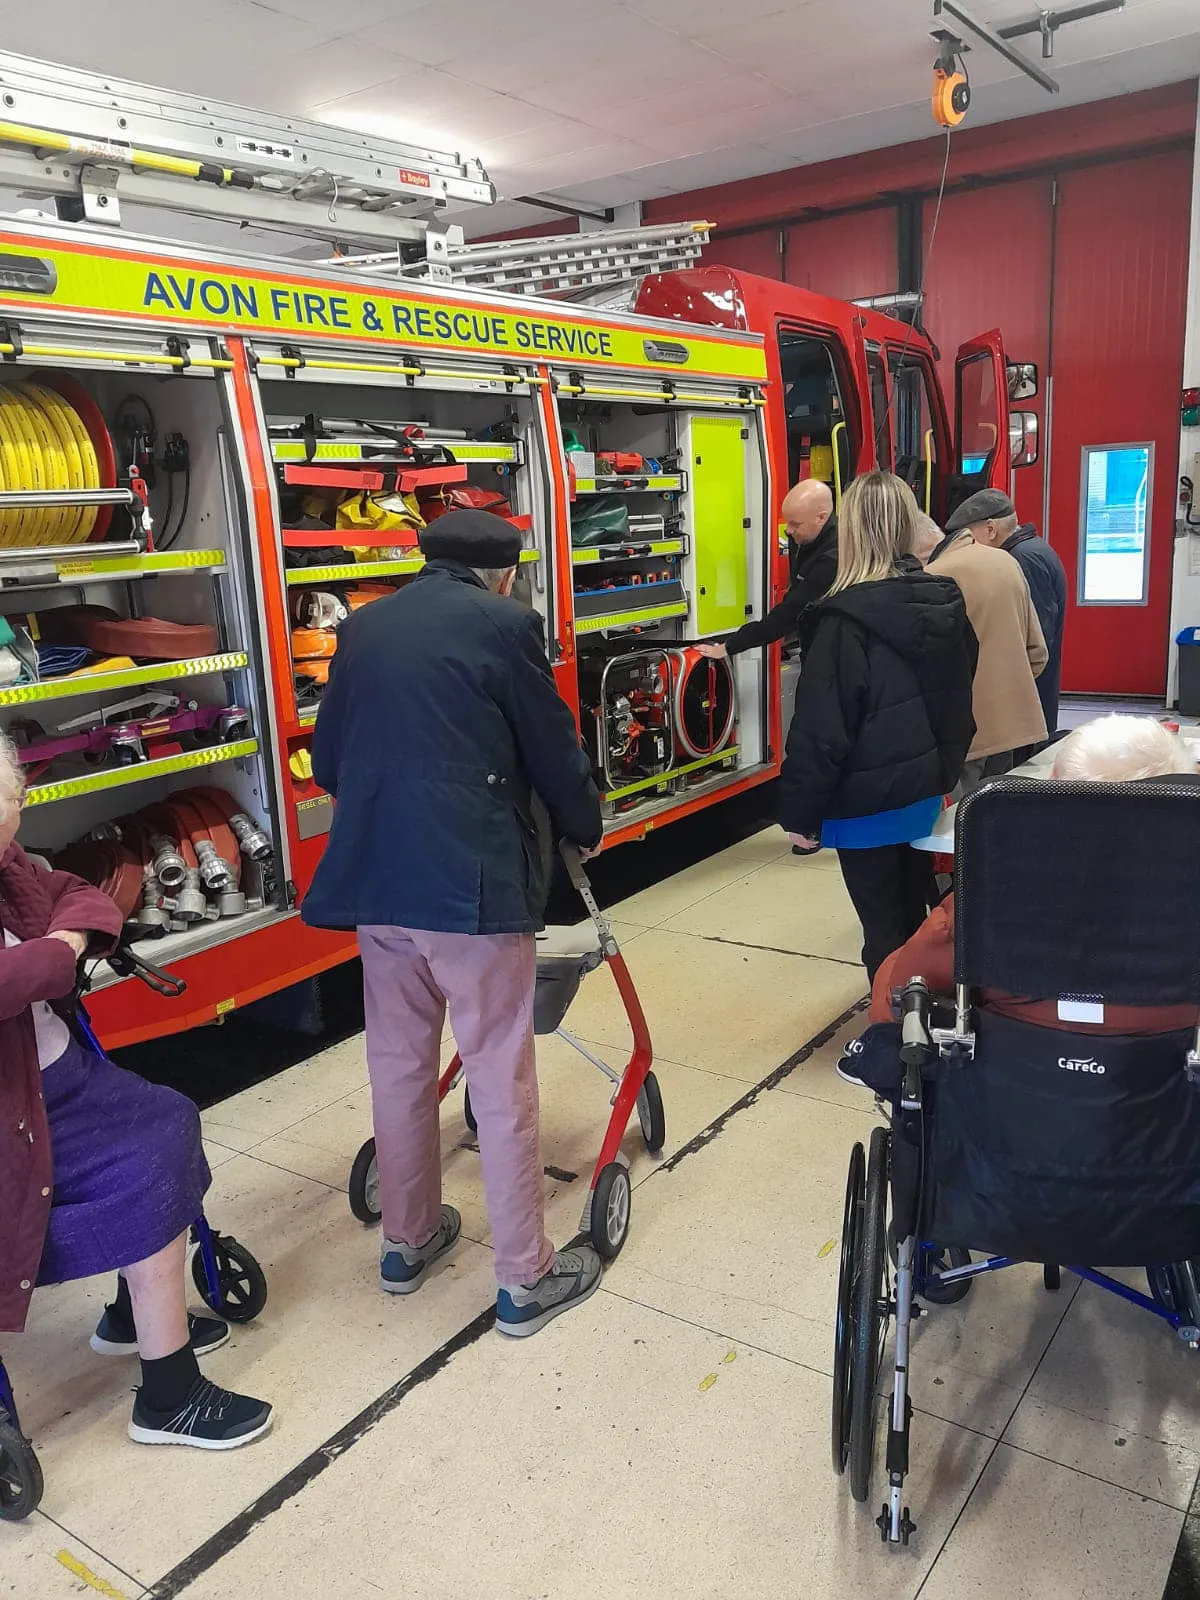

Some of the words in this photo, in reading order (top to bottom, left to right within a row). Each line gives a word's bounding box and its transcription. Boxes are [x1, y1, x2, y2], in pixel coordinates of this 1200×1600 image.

[143, 272, 259, 319] AVON
[270, 288, 352, 329] FIRE
[362, 301, 384, 332] &
[391, 304, 509, 346] RESCUE
[515, 321, 613, 357] SERVICE
[1057, 1057, 1106, 1074] CareCo
